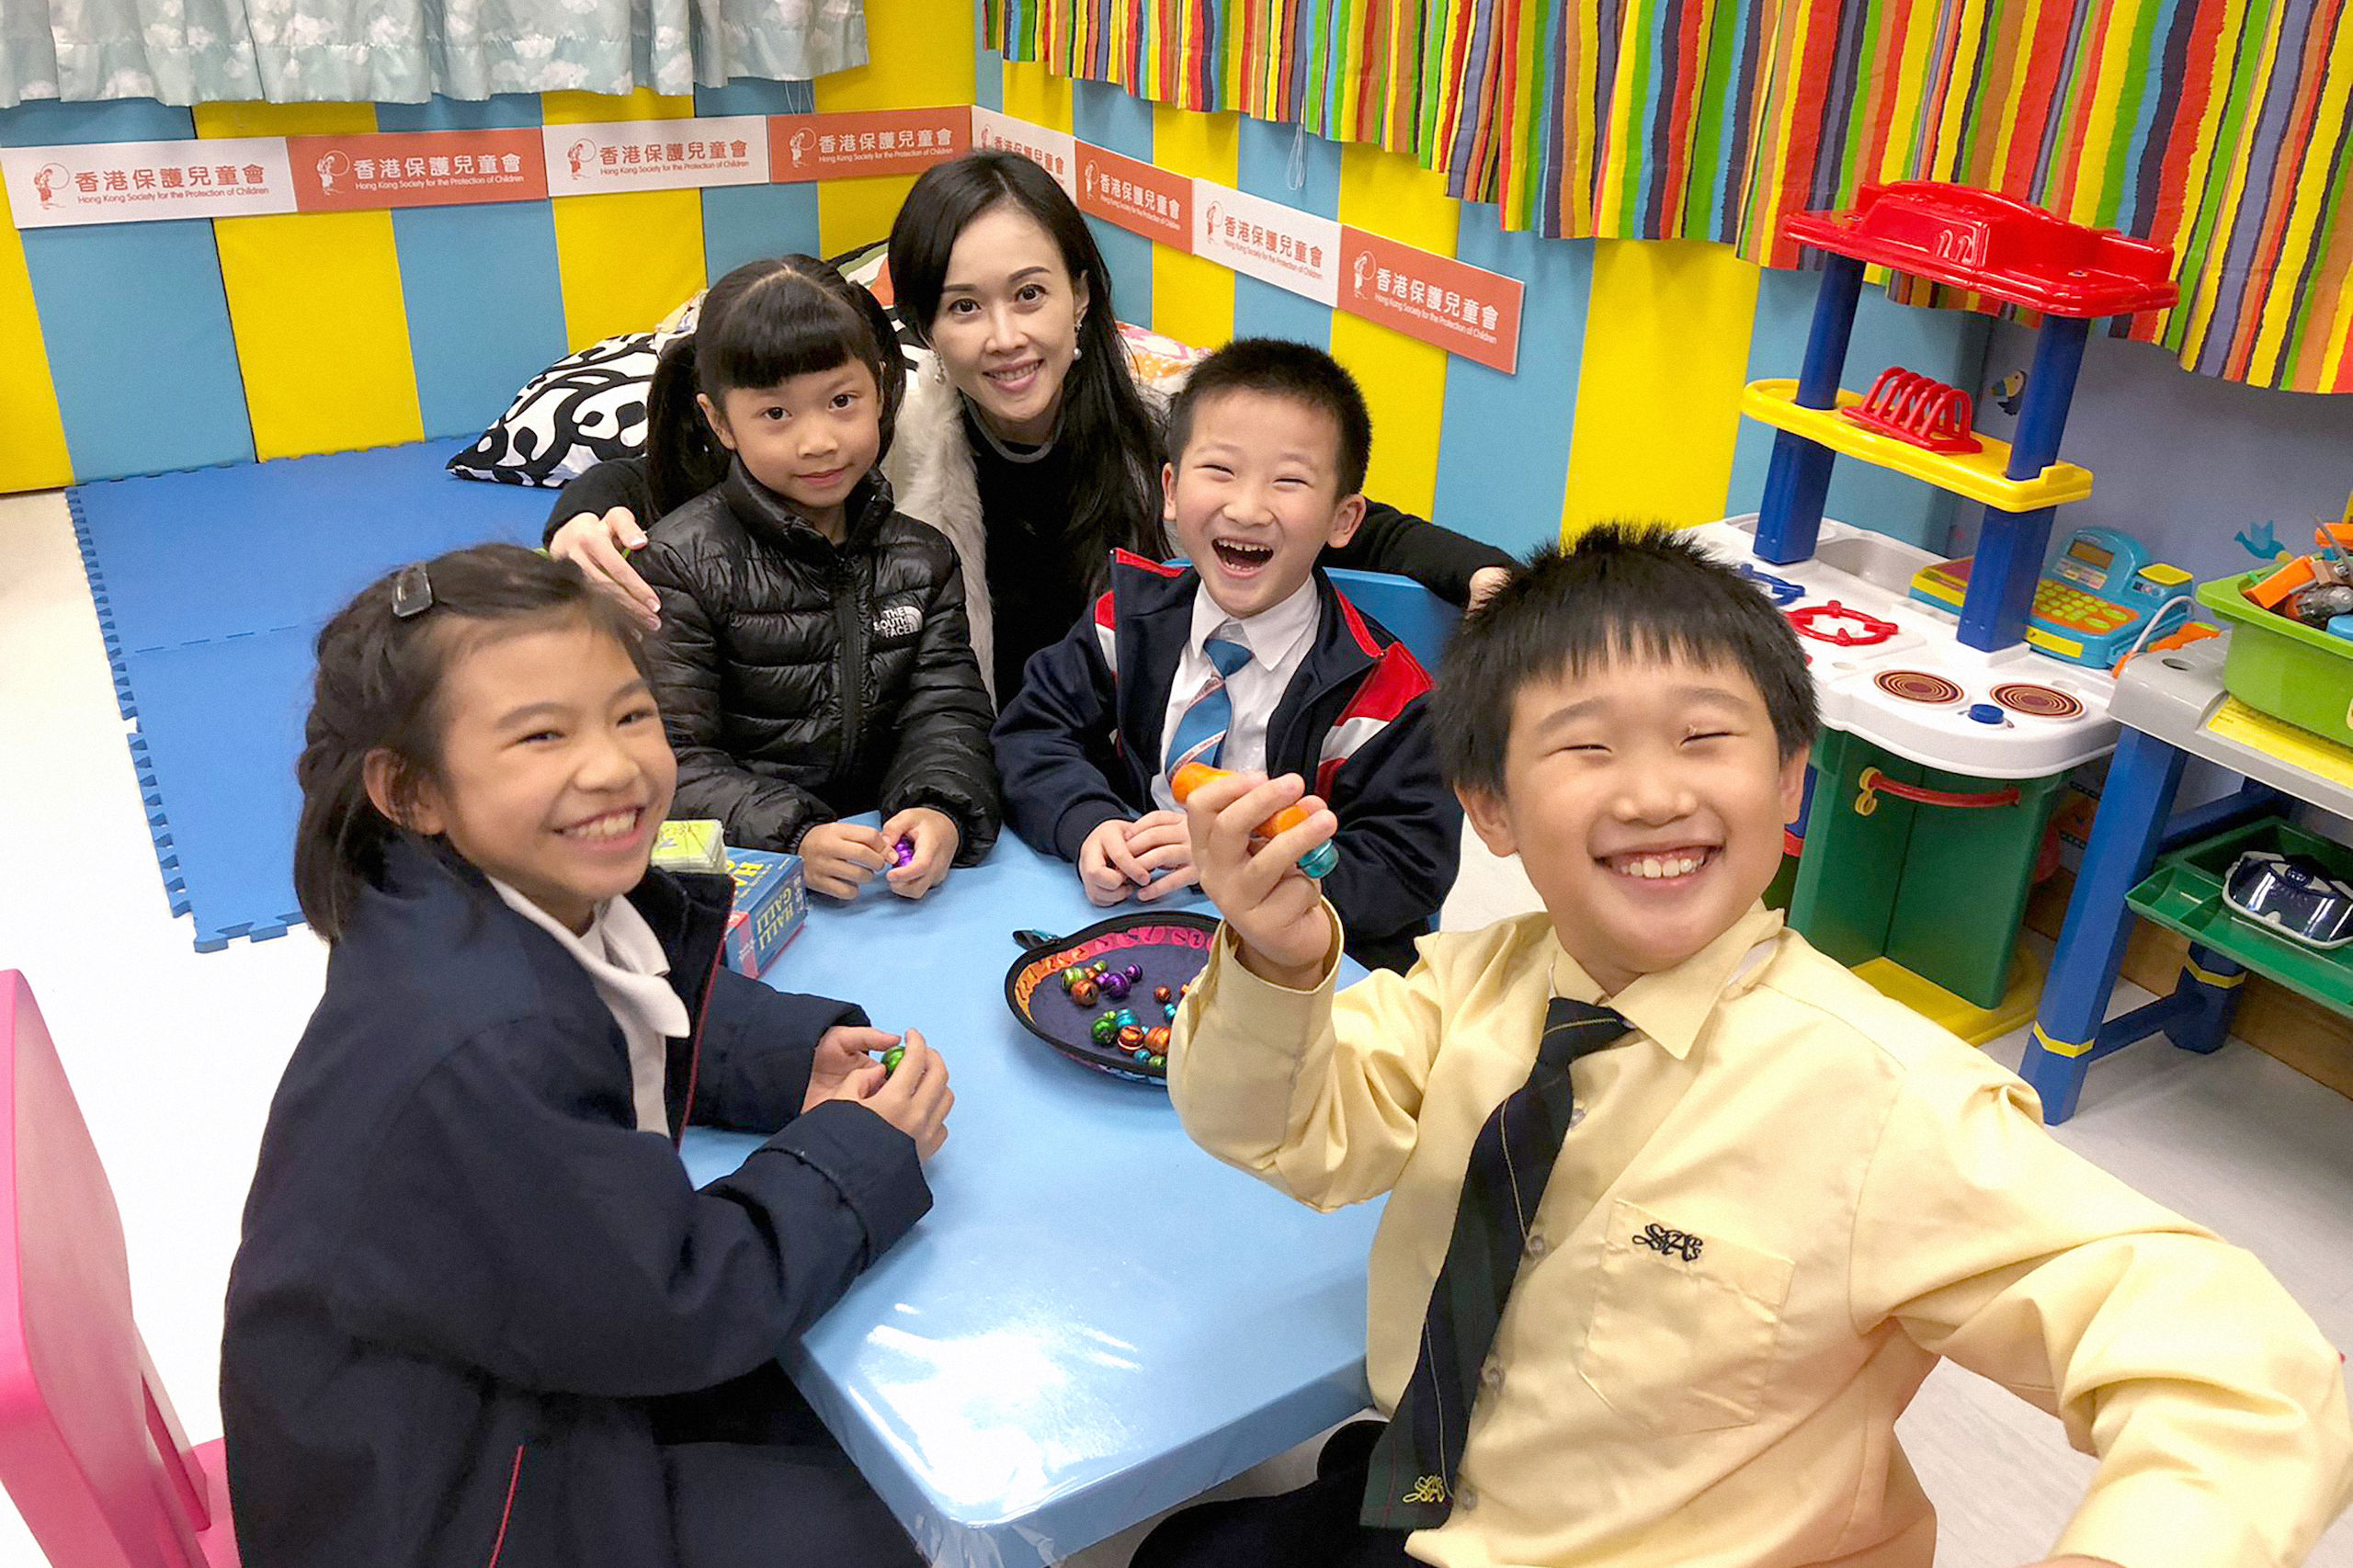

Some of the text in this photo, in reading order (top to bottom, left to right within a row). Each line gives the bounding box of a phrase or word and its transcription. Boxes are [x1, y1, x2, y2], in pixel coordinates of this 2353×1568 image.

[599, 140, 747, 165] 香港保護兒童會
[819, 128, 952, 153] 香港保護兒童會
[354, 153, 521, 179] 香港保護兒童會
[620, 166, 638, 175] Kong
[684, 162, 715, 170] Protection
[854, 153, 873, 161] Society
[74, 164, 265, 193] 香港保護兒童會
[356, 182, 377, 191] Hong
[379, 181, 398, 189] Kong
[399, 179, 425, 188] Society
[438, 178, 449, 187] the
[450, 176, 485, 185] Protection
[78, 195, 101, 204] Hong
[104, 194, 125, 203] Kong
[127, 191, 155, 201] Society
[157, 191, 168, 199] for
[186, 188, 224, 198] Protection
[237, 187, 268, 195] Children
[1100, 173, 1180, 220] 香港保護兒童會
[1225, 216, 1323, 267] 香港保護兒童會
[1377, 268, 1498, 331] 香港保護兒童會
[883, 607, 905, 619] THE
[885, 625, 911, 638] FACE
[759, 903, 794, 951] HALLI
